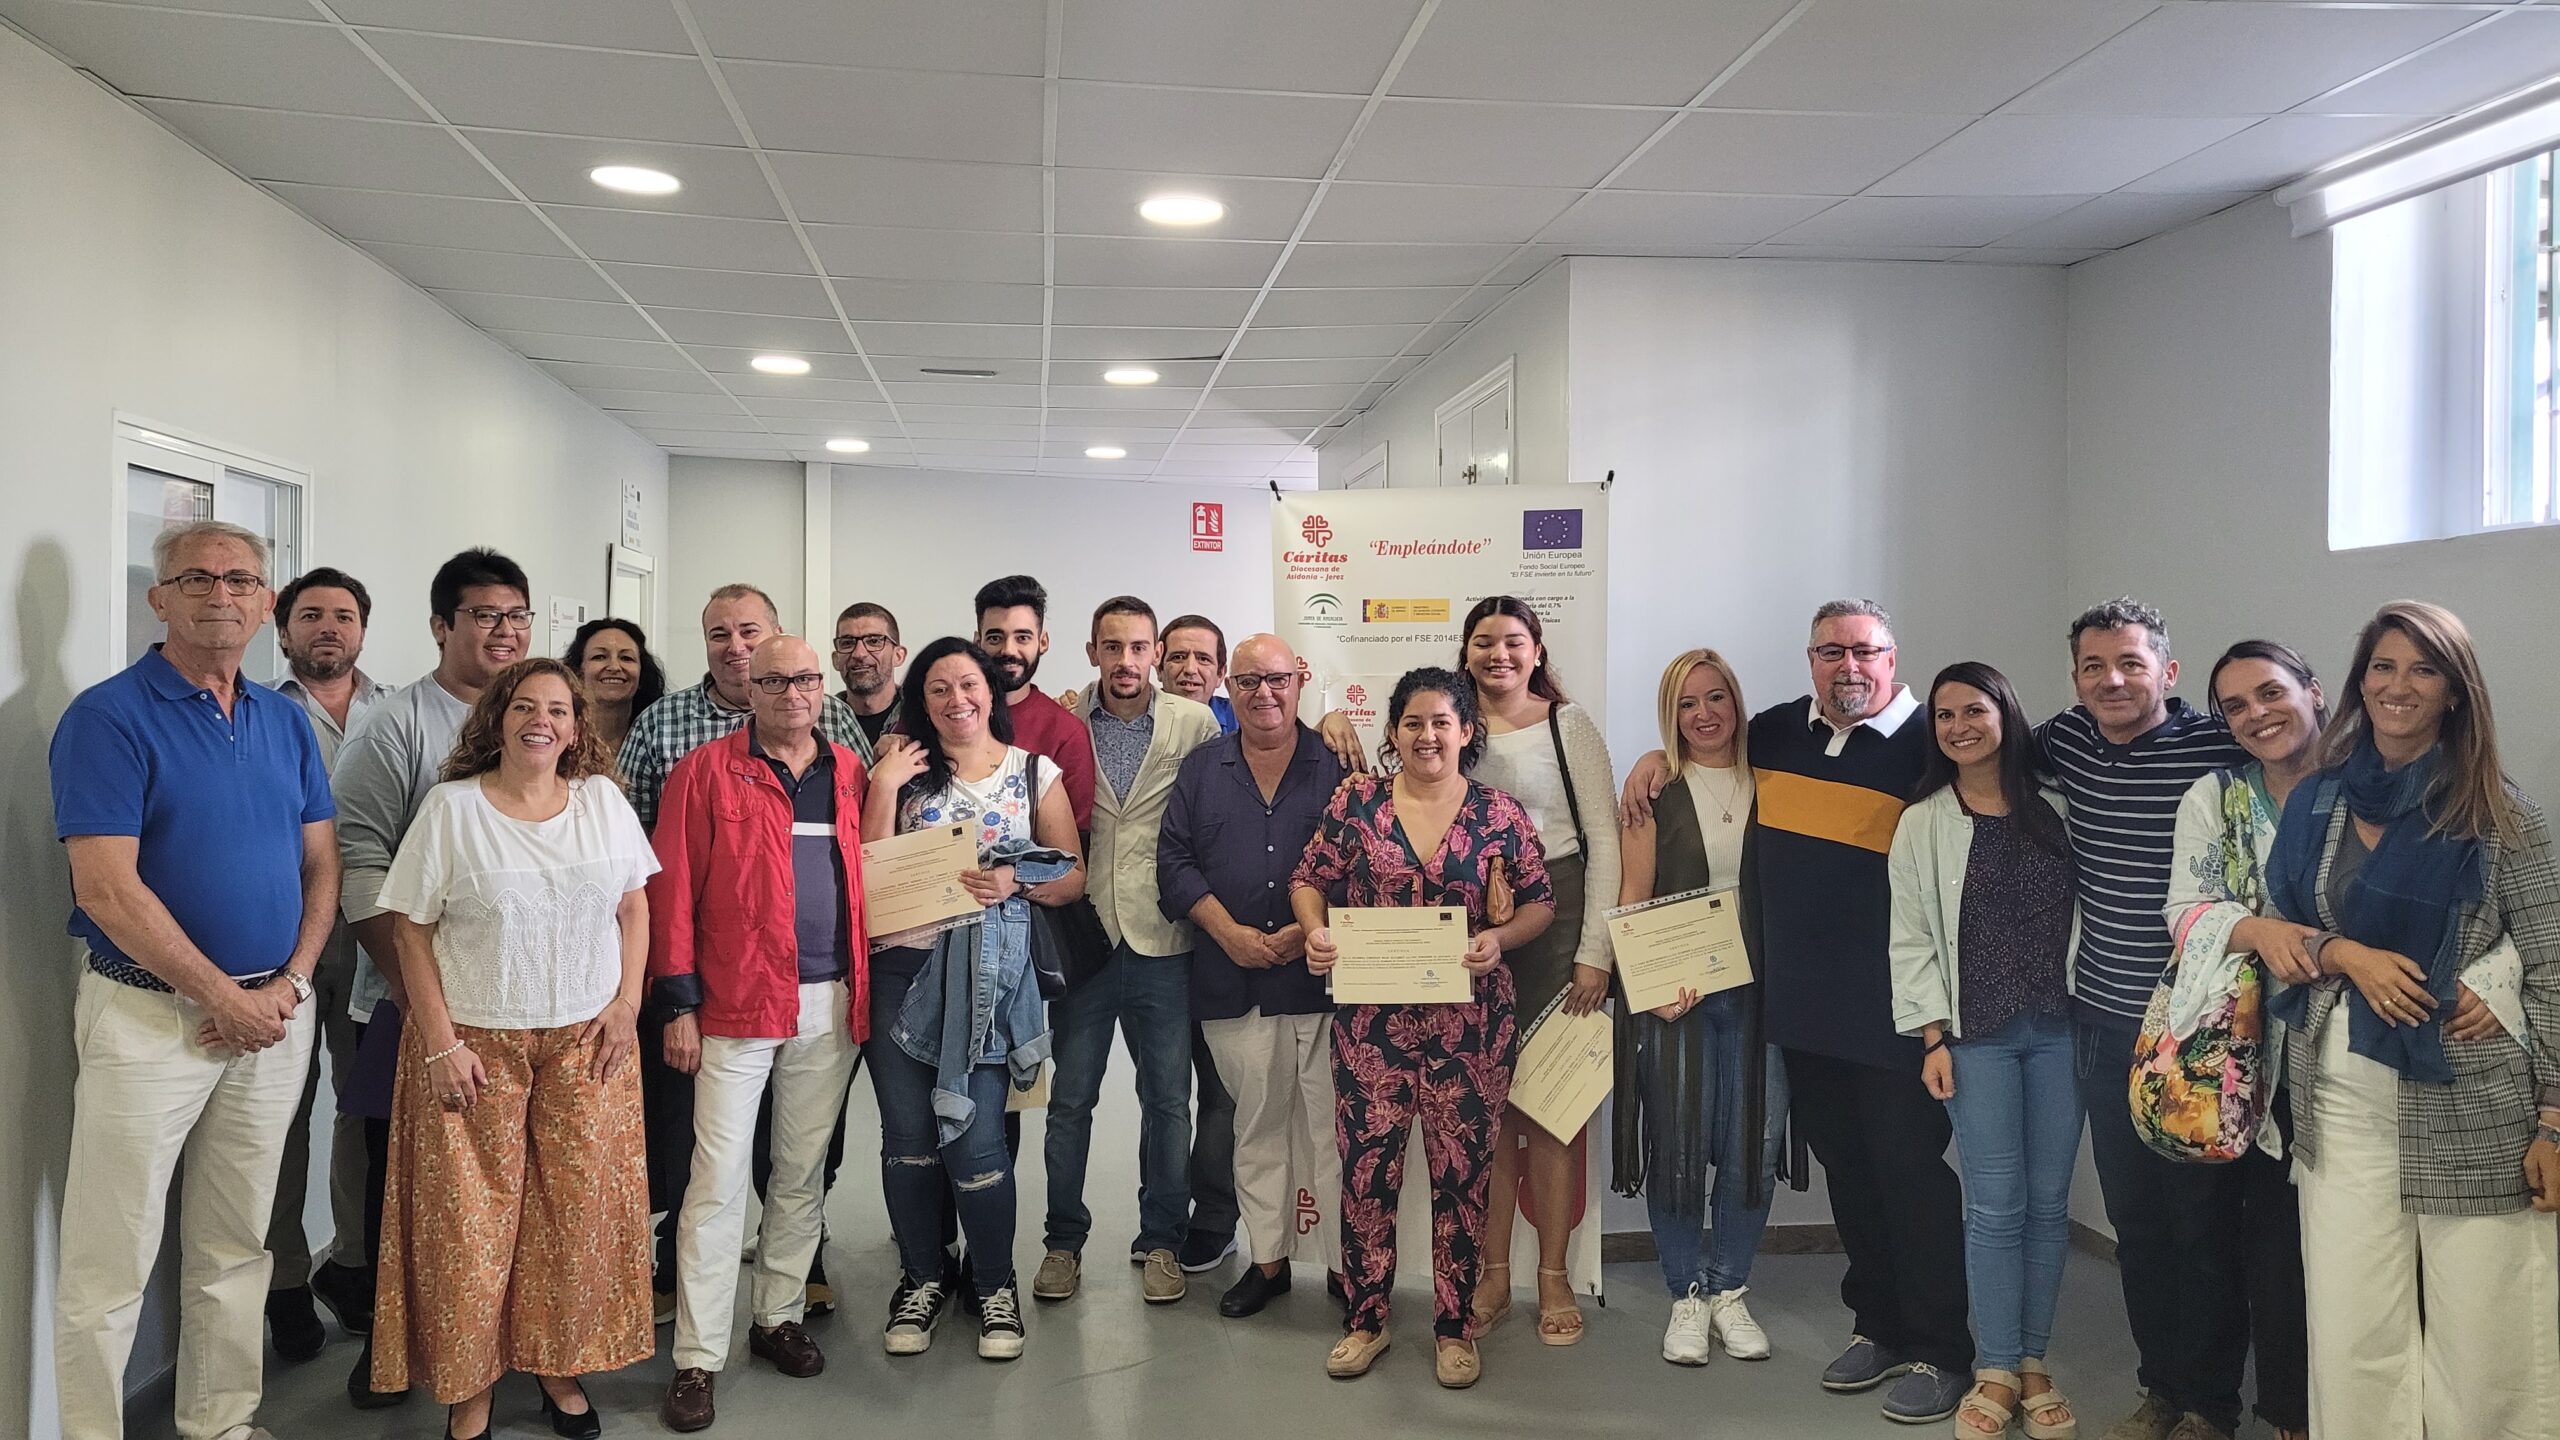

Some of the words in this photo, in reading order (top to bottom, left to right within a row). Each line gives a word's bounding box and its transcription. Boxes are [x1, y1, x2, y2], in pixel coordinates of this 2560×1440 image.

[1193, 540, 1222, 551] EXTINTOR
[1283, 550, 1348, 563] Cáritas
[1522, 551, 1546, 560] Unión
[1548, 551, 1583, 560] Europea
[1519, 563, 1539, 571] Fondo
[1559, 562, 1586, 570] Europeo
[1325, 573, 1345, 582] Jerez
[1391, 635, 1404, 644] por
[1405, 634, 1413, 643] el
[1415, 634, 1432, 643] FSE
